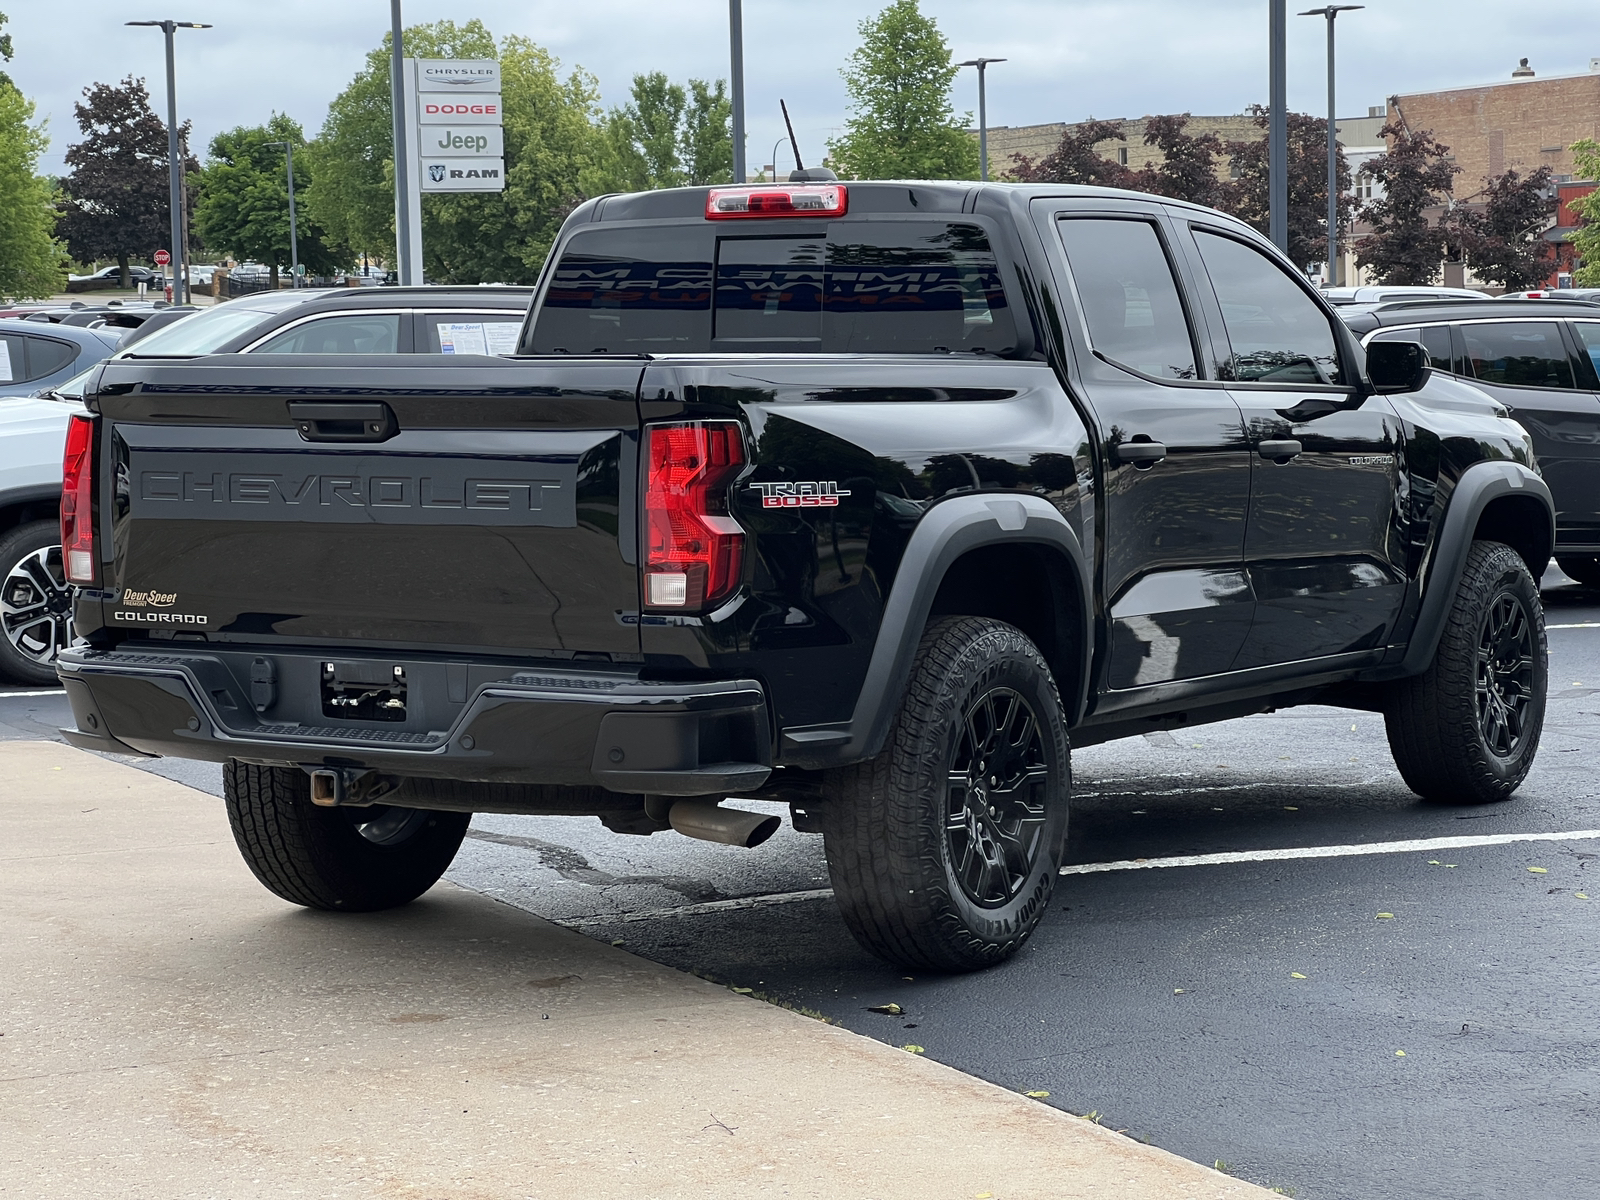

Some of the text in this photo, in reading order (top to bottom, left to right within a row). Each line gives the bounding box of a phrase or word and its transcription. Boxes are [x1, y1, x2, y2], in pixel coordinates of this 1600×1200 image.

[425, 105, 497, 114] DODGE
[438, 131, 488, 153] Jeep
[450, 169, 499, 178] RAM
[1348, 455, 1394, 465] COLORADO
[140, 470, 563, 511] CHEVROLET
[749, 481, 852, 497] TRAIL
[763, 495, 839, 509] BOSS
[123, 588, 177, 607] Deur Speet
[114, 611, 208, 625] COLORADO
[959, 657, 1034, 718] WRANGLER
[975, 872, 1050, 937] GOODYEAR
